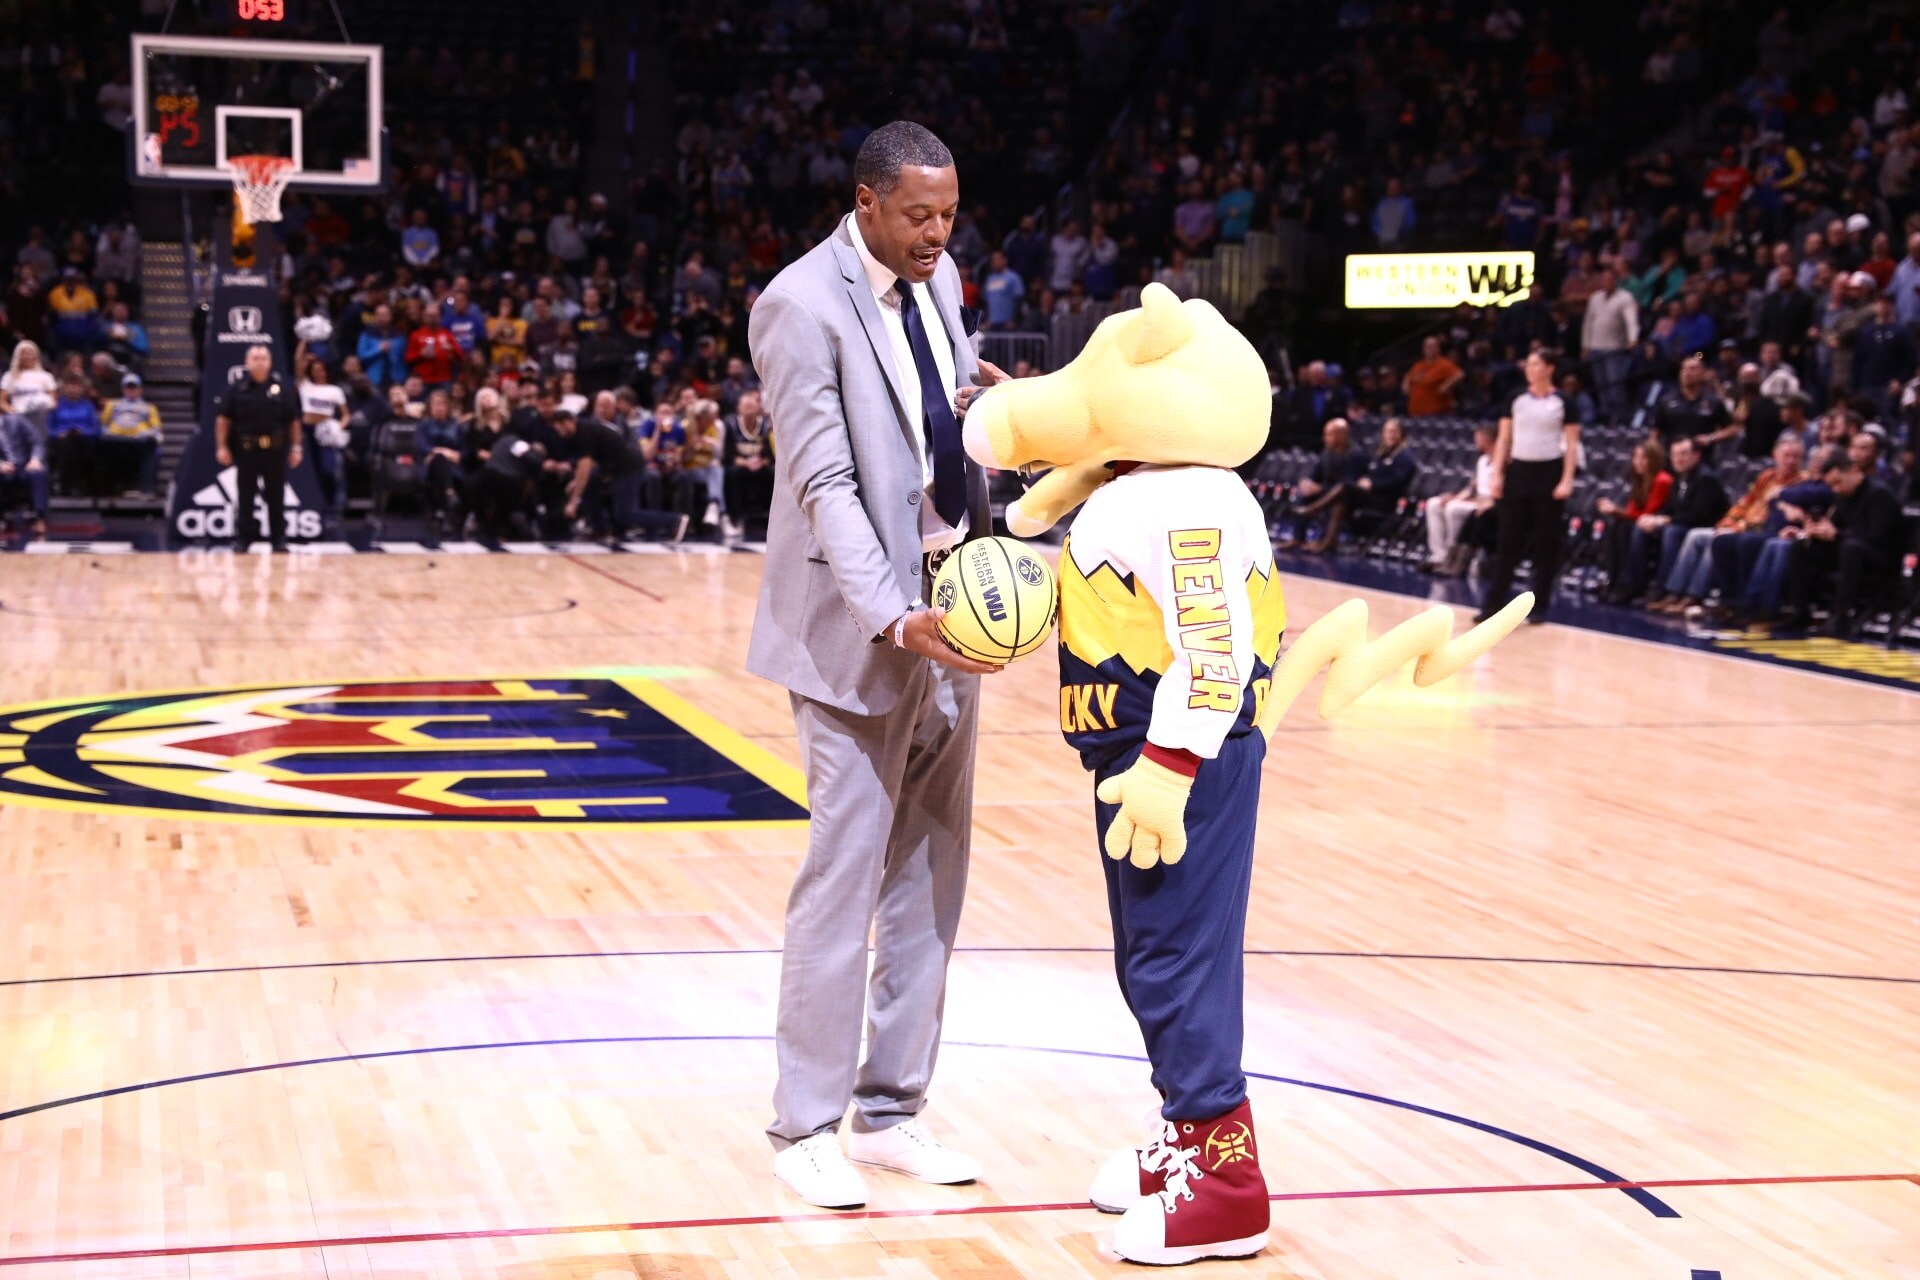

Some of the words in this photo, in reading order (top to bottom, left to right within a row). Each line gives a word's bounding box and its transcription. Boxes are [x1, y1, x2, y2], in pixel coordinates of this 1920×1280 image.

[1356, 264, 1459, 280] WESTERN
[176, 503, 322, 538] adas
[971, 554, 988, 587] UNION
[982, 586, 1008, 622] WU
[1168, 528, 1241, 713] DENVER
